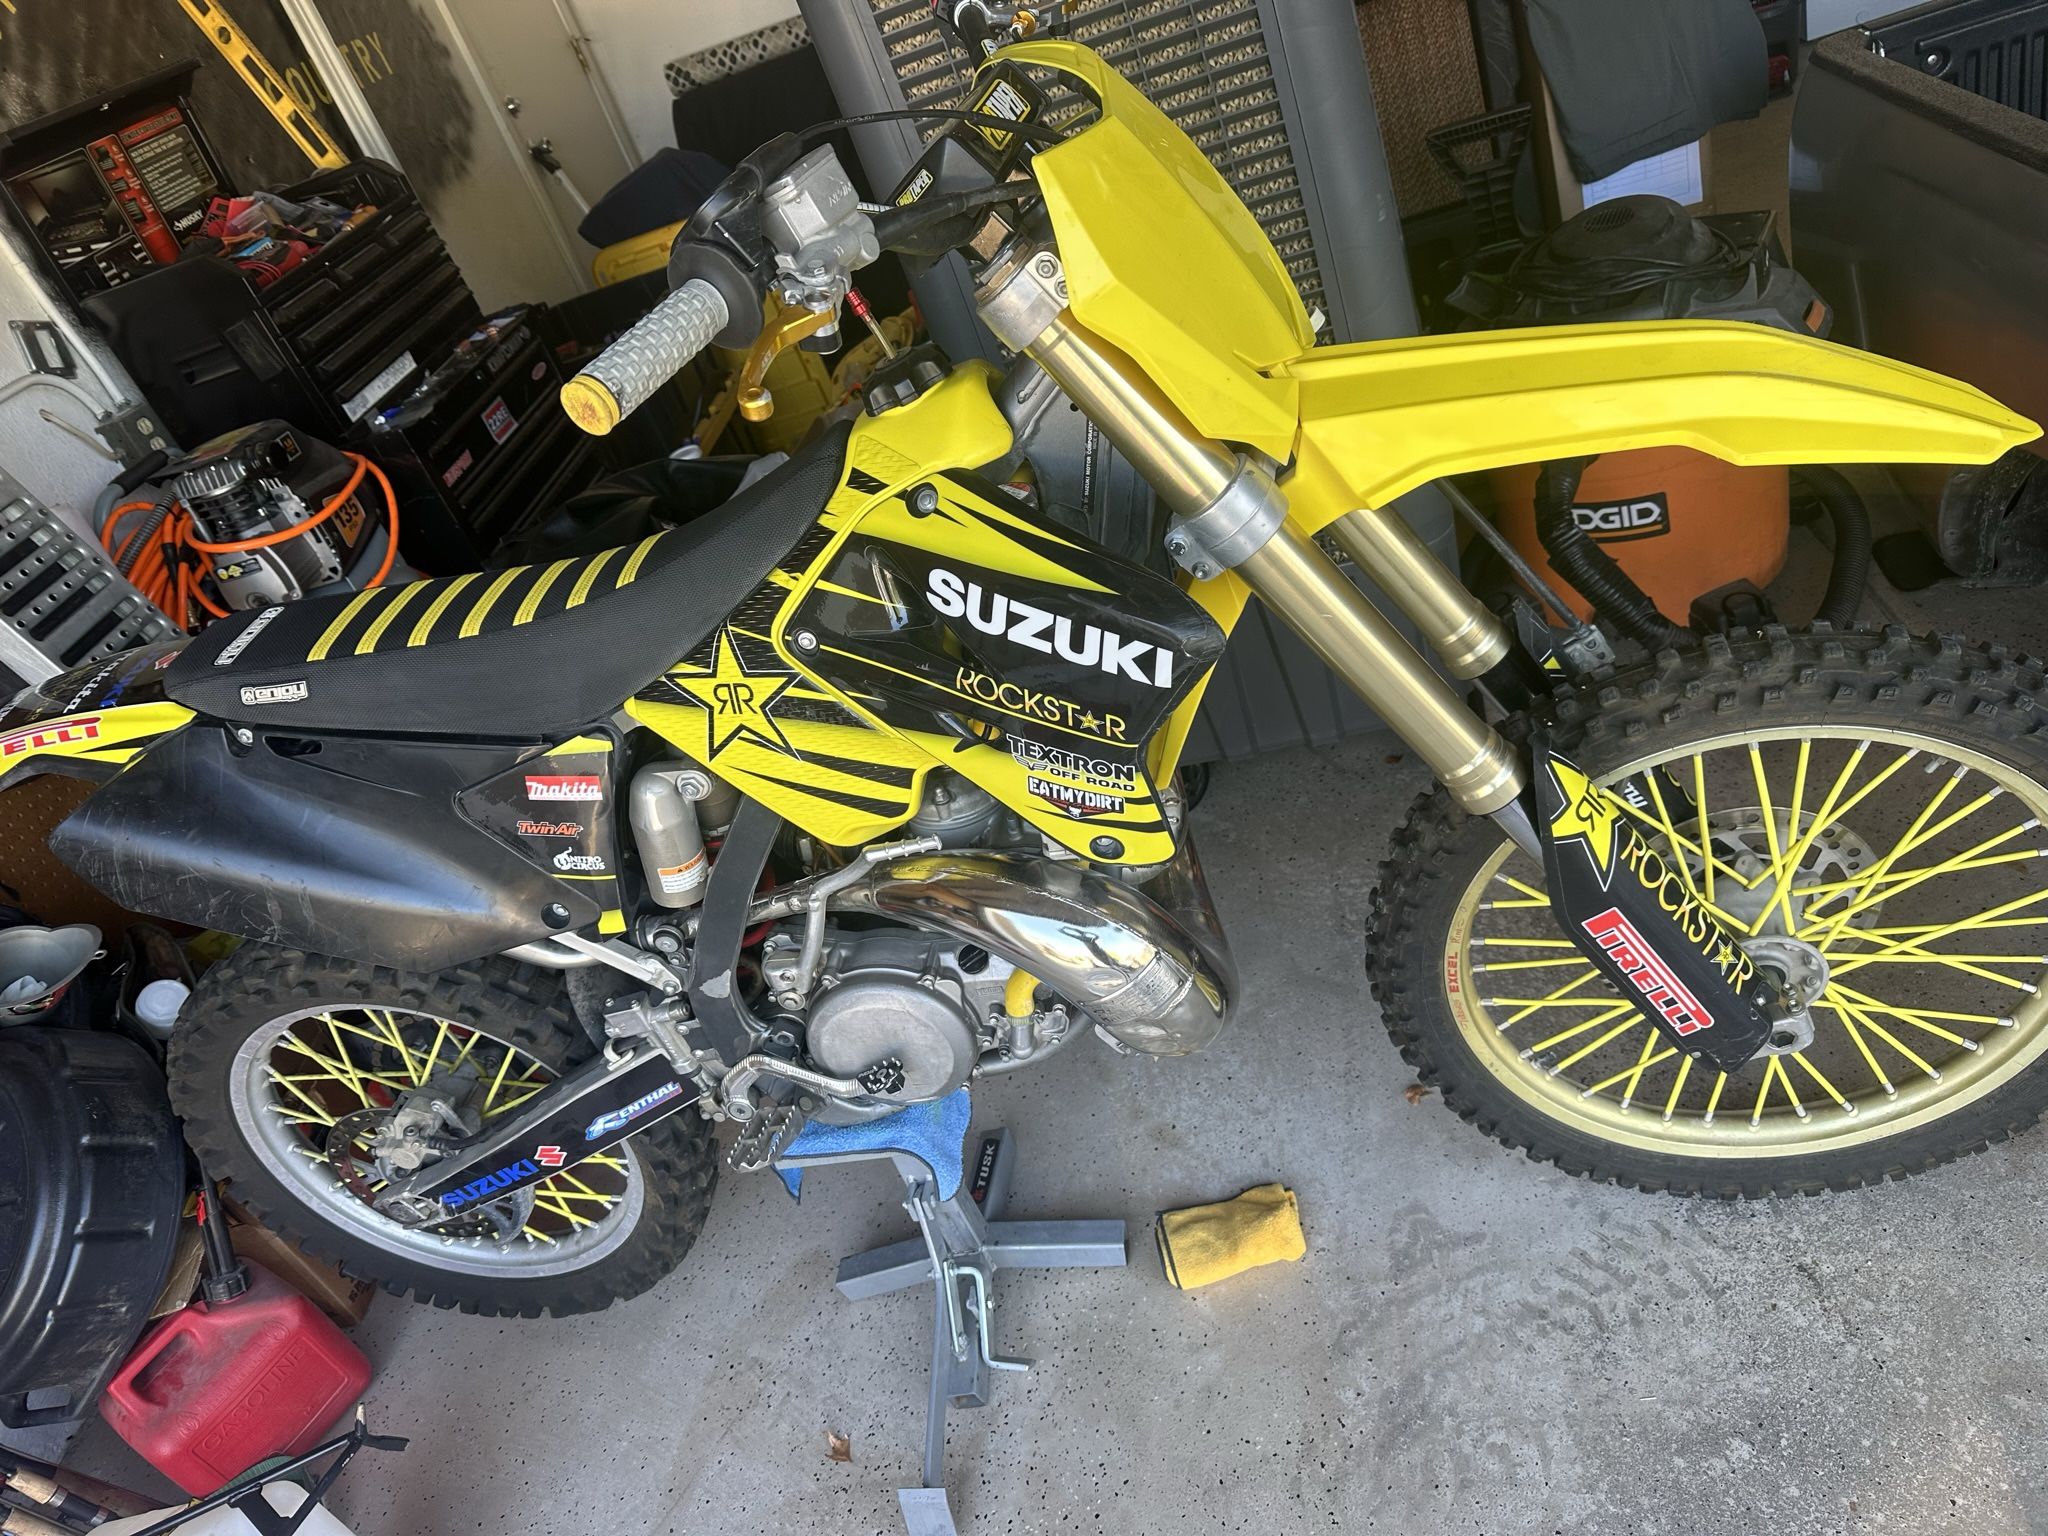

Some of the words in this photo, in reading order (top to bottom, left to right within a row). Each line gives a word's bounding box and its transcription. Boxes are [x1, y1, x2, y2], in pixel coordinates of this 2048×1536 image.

[264, 31, 393, 121] OUTRY
[181, 208, 205, 228] HUSKY
[487, 405, 511, 431] 22RE
[334, 502, 360, 528] 135
[1571, 501, 1661, 530] DGID
[925, 568, 1174, 689] SUZUKI
[0, 718, 101, 757] ELLI
[1006, 733, 1136, 783] TEXTRON
[526, 780, 600, 799] makita
[1028, 776, 1123, 812] EATMYDIRT
[1049, 767, 1081, 781] OFF
[1086, 776, 1136, 792] ROAD
[570, 855, 602, 864] NITRO
[570, 862, 606, 871] CIRCUS
[1447, 951, 1460, 993] EXCEL
[1581, 907, 1715, 1037] PIRELLI
[585, 1081, 682, 1142] RENTHAL
[441, 1158, 540, 1207] SUZUKI
[976, 1144, 996, 1188] TUSK
